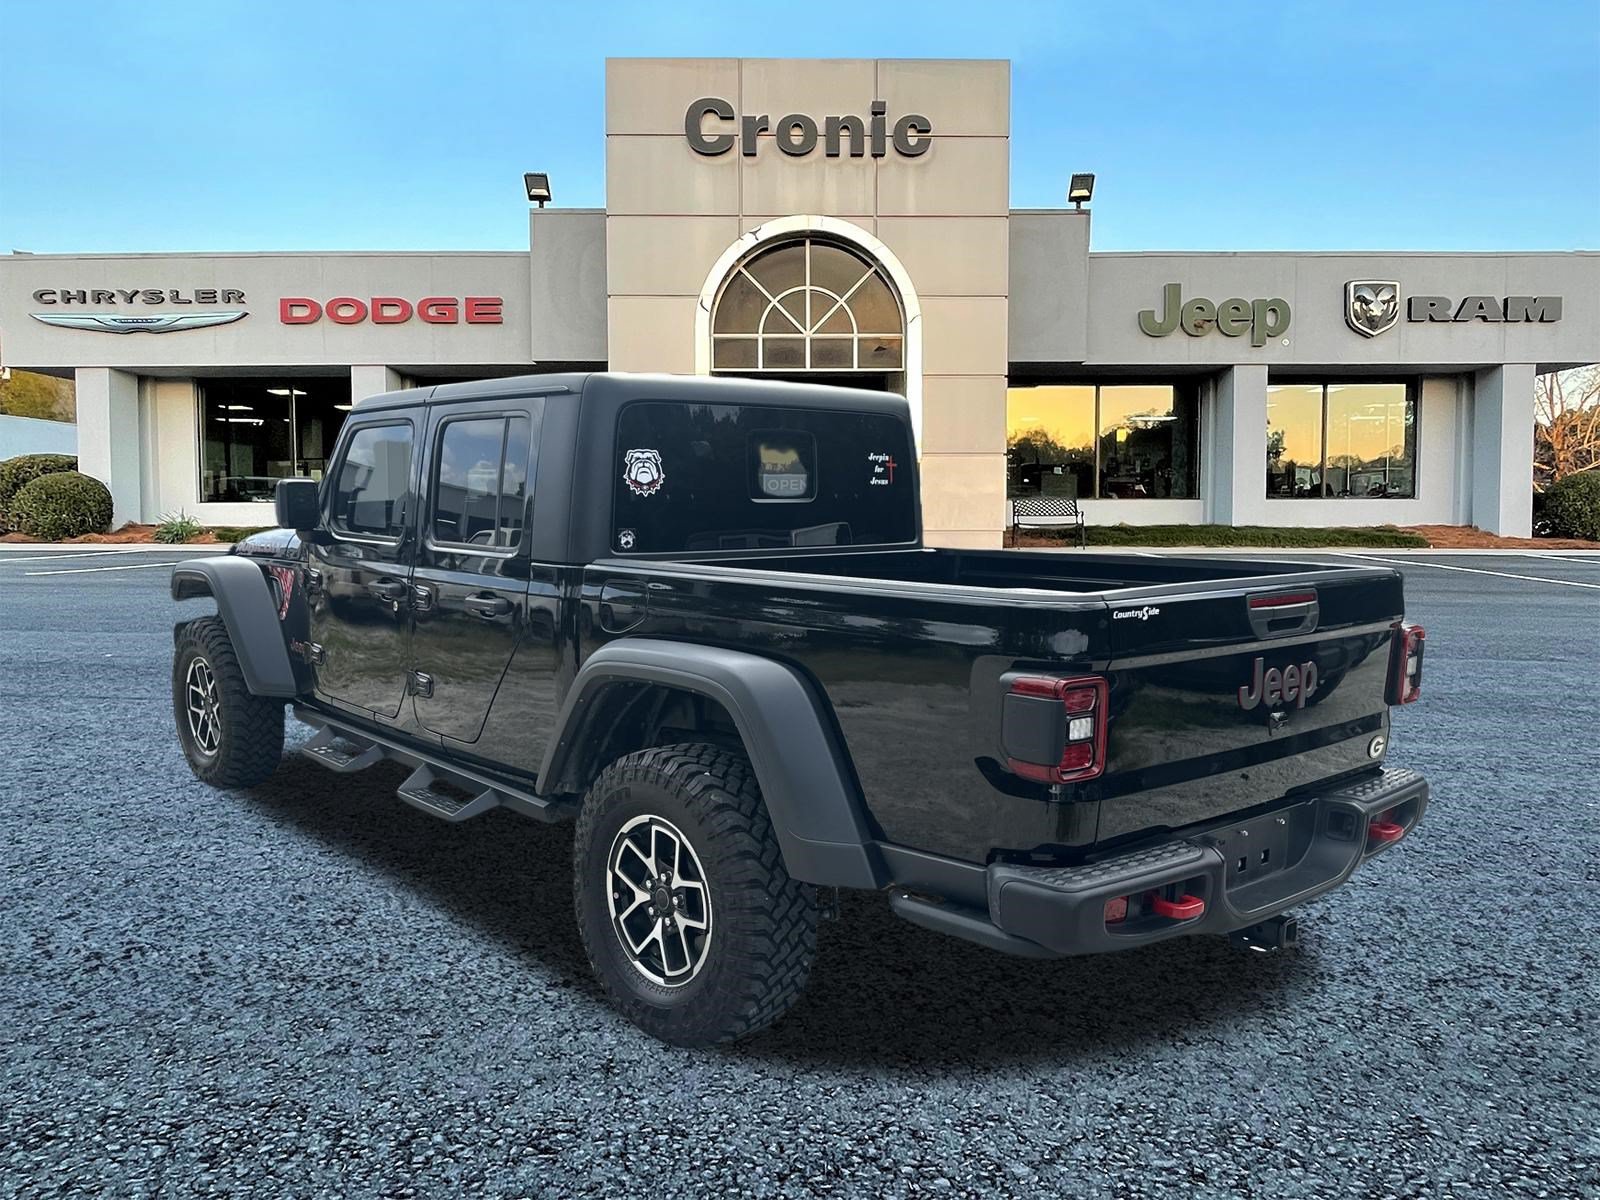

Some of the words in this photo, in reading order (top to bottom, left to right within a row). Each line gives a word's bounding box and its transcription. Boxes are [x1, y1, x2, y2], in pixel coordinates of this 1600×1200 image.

[684, 97, 933, 158] Cronic
[32, 288, 247, 305] CHRYSLER
[280, 296, 504, 325] DODGE
[1407, 295, 1563, 323] RAM
[1137, 282, 1292, 347] Jeep
[1113, 605, 1160, 621] CountrySide
[1237, 656, 1318, 711] Jeep
